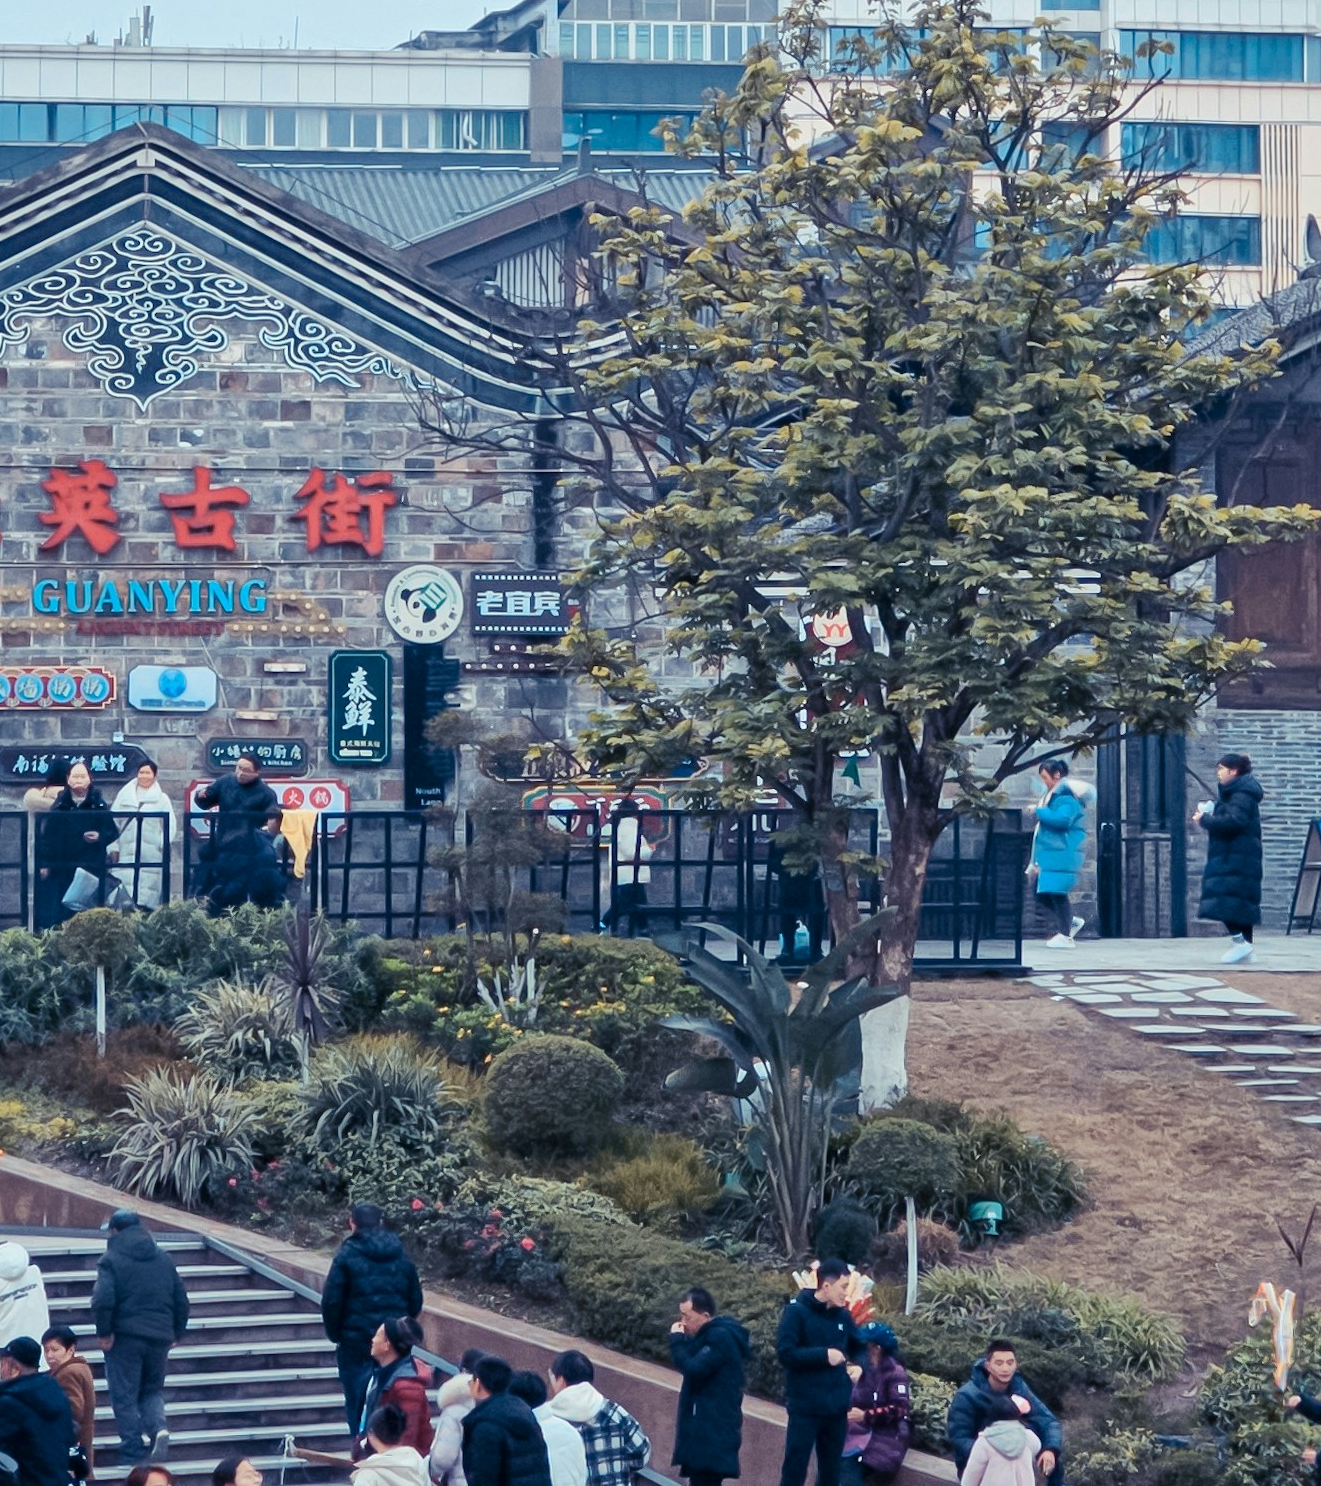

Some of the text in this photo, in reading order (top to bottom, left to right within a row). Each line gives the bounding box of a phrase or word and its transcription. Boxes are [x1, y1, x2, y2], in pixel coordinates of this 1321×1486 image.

[32, 579, 268, 613] GUANYING
[476, 590, 561, 617] 老宜宾
[342, 666, 378, 737] 泰鲜
